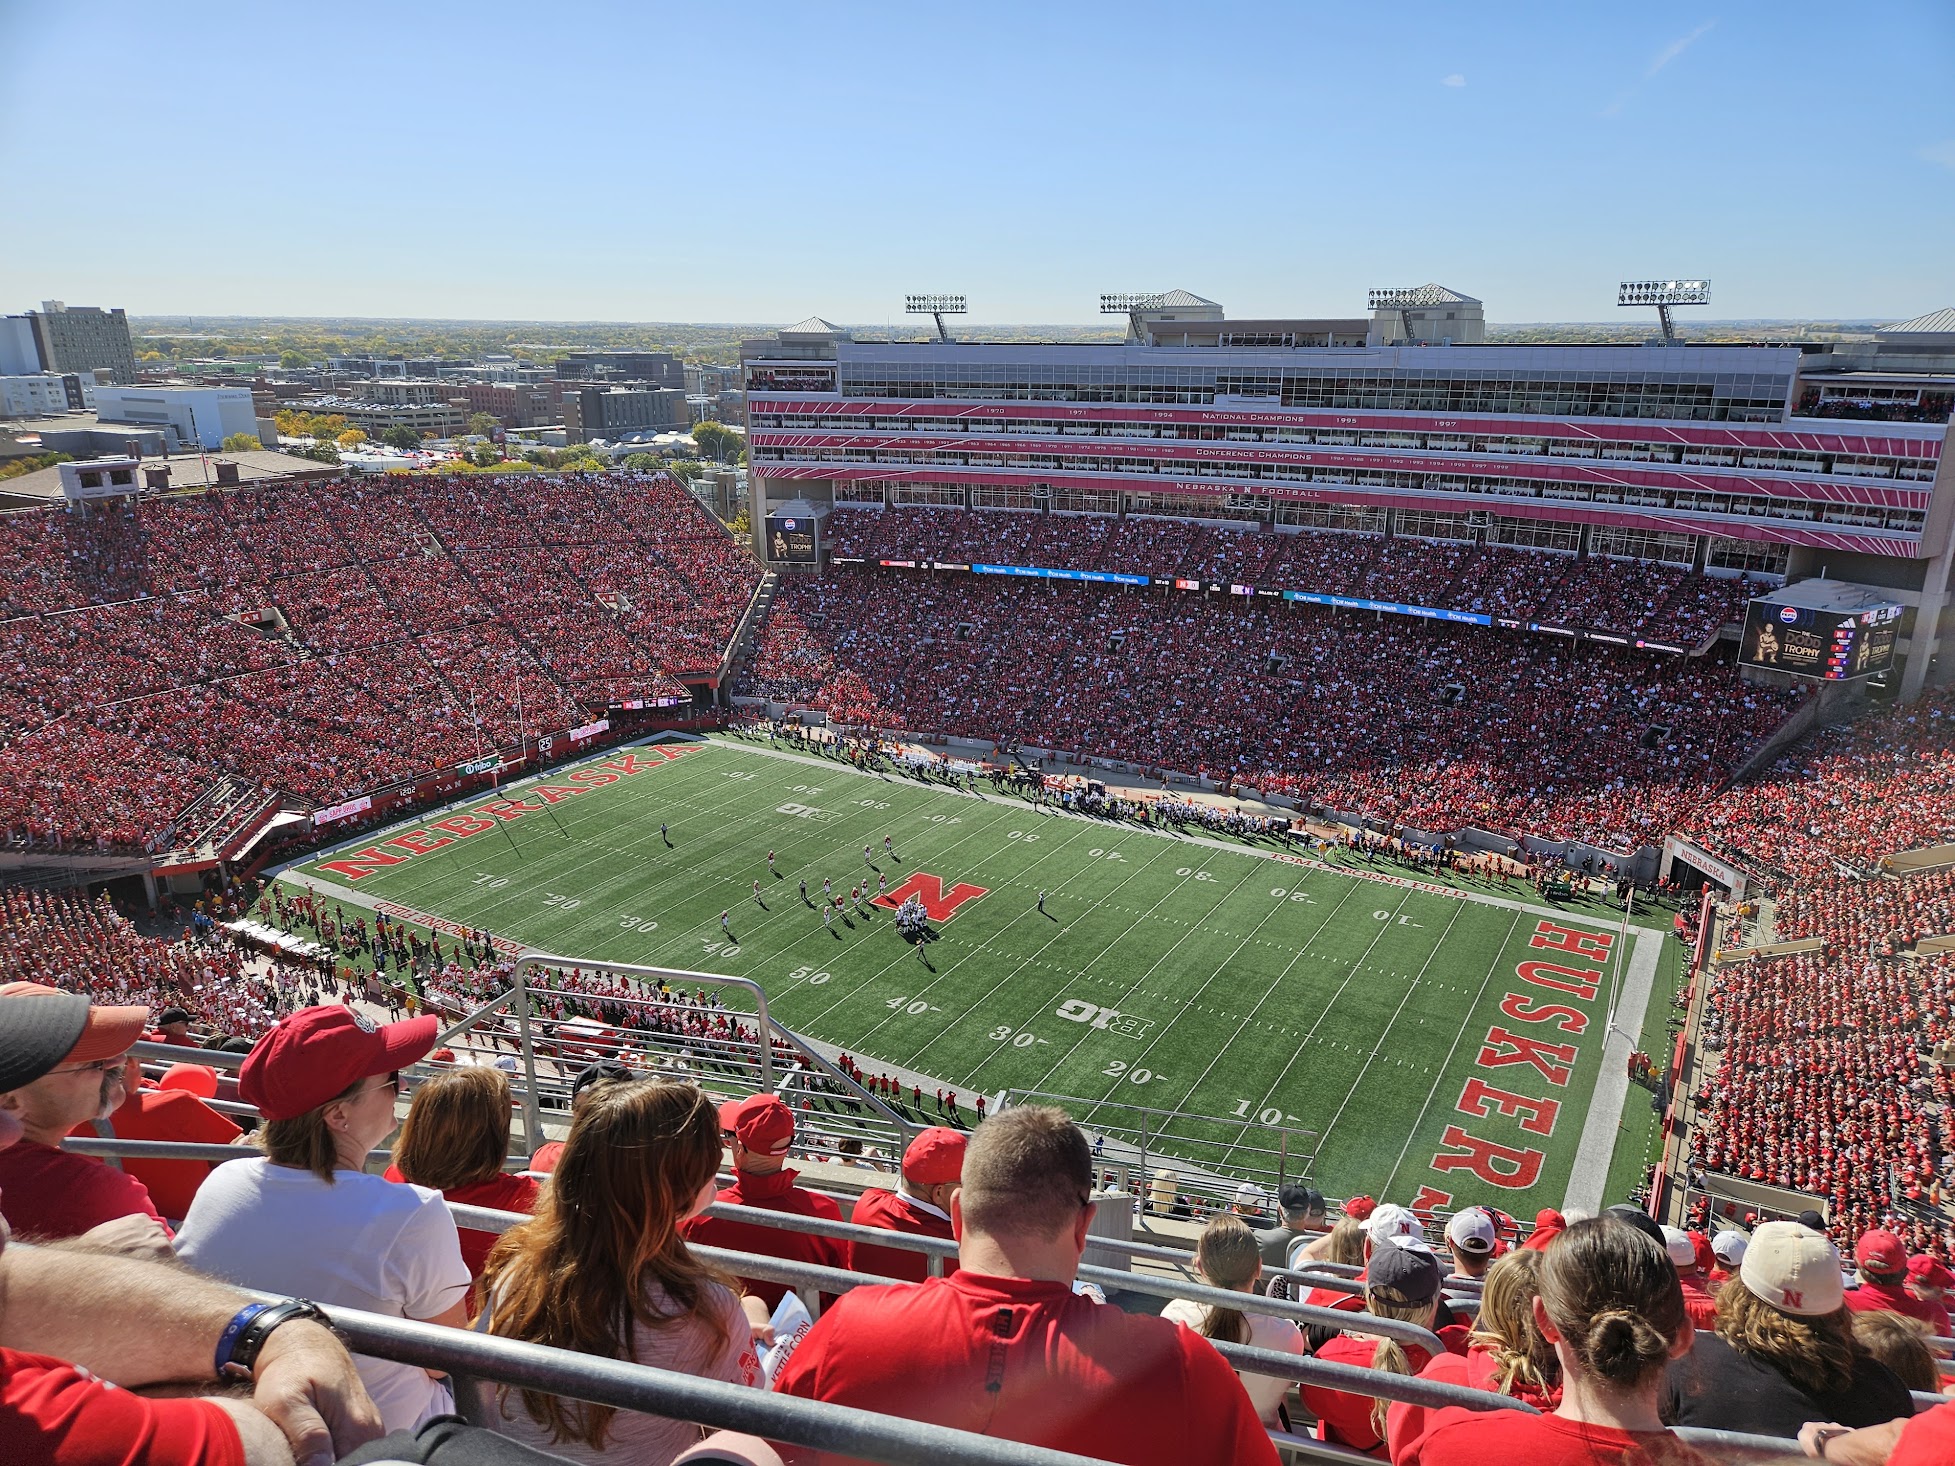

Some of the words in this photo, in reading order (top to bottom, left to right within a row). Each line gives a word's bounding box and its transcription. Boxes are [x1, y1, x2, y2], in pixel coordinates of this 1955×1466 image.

[1202, 412, 1247, 421] NATIONAL
[1250, 414, 1304, 423] CHAMPIONS
[1196, 448, 1254, 458] CONFERENCE
[1258, 451, 1312, 461] CHAMPIONS
[1176, 482, 1235, 492] NEBRASKA
[1262, 487, 1320, 498] FOOTBALL
[790, 536, 812, 544] DODD
[1786, 632, 1821, 648] DODD
[1784, 644, 1820, 657] TROPHY
[540, 739, 550, 748] 25
[728, 772, 758, 780] 10
[400, 786, 416, 796] 12:02
[792, 785, 824, 794] 20
[316, 744, 708, 880] NEBRASKA
[329, 808, 342, 817] SAPP
[860, 800, 890, 810] 30
[934, 813, 962, 825] 40
[1007, 830, 1041, 843] 50
[1666, 840, 1673, 850] N
[1088, 848, 1121, 861] 40
[1681, 849, 1725, 880] NEBRASKA
[472, 873, 508, 888] 10
[1175, 867, 1211, 881] 30
[1270, 853, 1312, 866] TOM
[1317, 863, 1407, 886] OSBORNE
[1411, 882, 1468, 898] FIELD
[1735, 880, 1743, 890] N
[542, 894, 581, 910] 20
[870, 872, 990, 923] N
[1270, 888, 1310, 902] 20
[374, 902, 418, 919] FIELD
[1373, 910, 1414, 925] 10
[620, 916, 658, 933] 30
[490, 937, 527, 954] TOM
[703, 942, 741, 958] 40
[790, 966, 831, 985] 50
[886, 997, 929, 1016] 40
[988, 1025, 1036, 1049] 30
[1102, 1060, 1154, 1085] 20
[1229, 1099, 1284, 1126] 10
[1400, 1222, 1410, 1234] N
[1782, 1288, 1803, 1309] N
[771, 1348, 791, 1383] KETTLE
[790, 1320, 811, 1351] CORN
